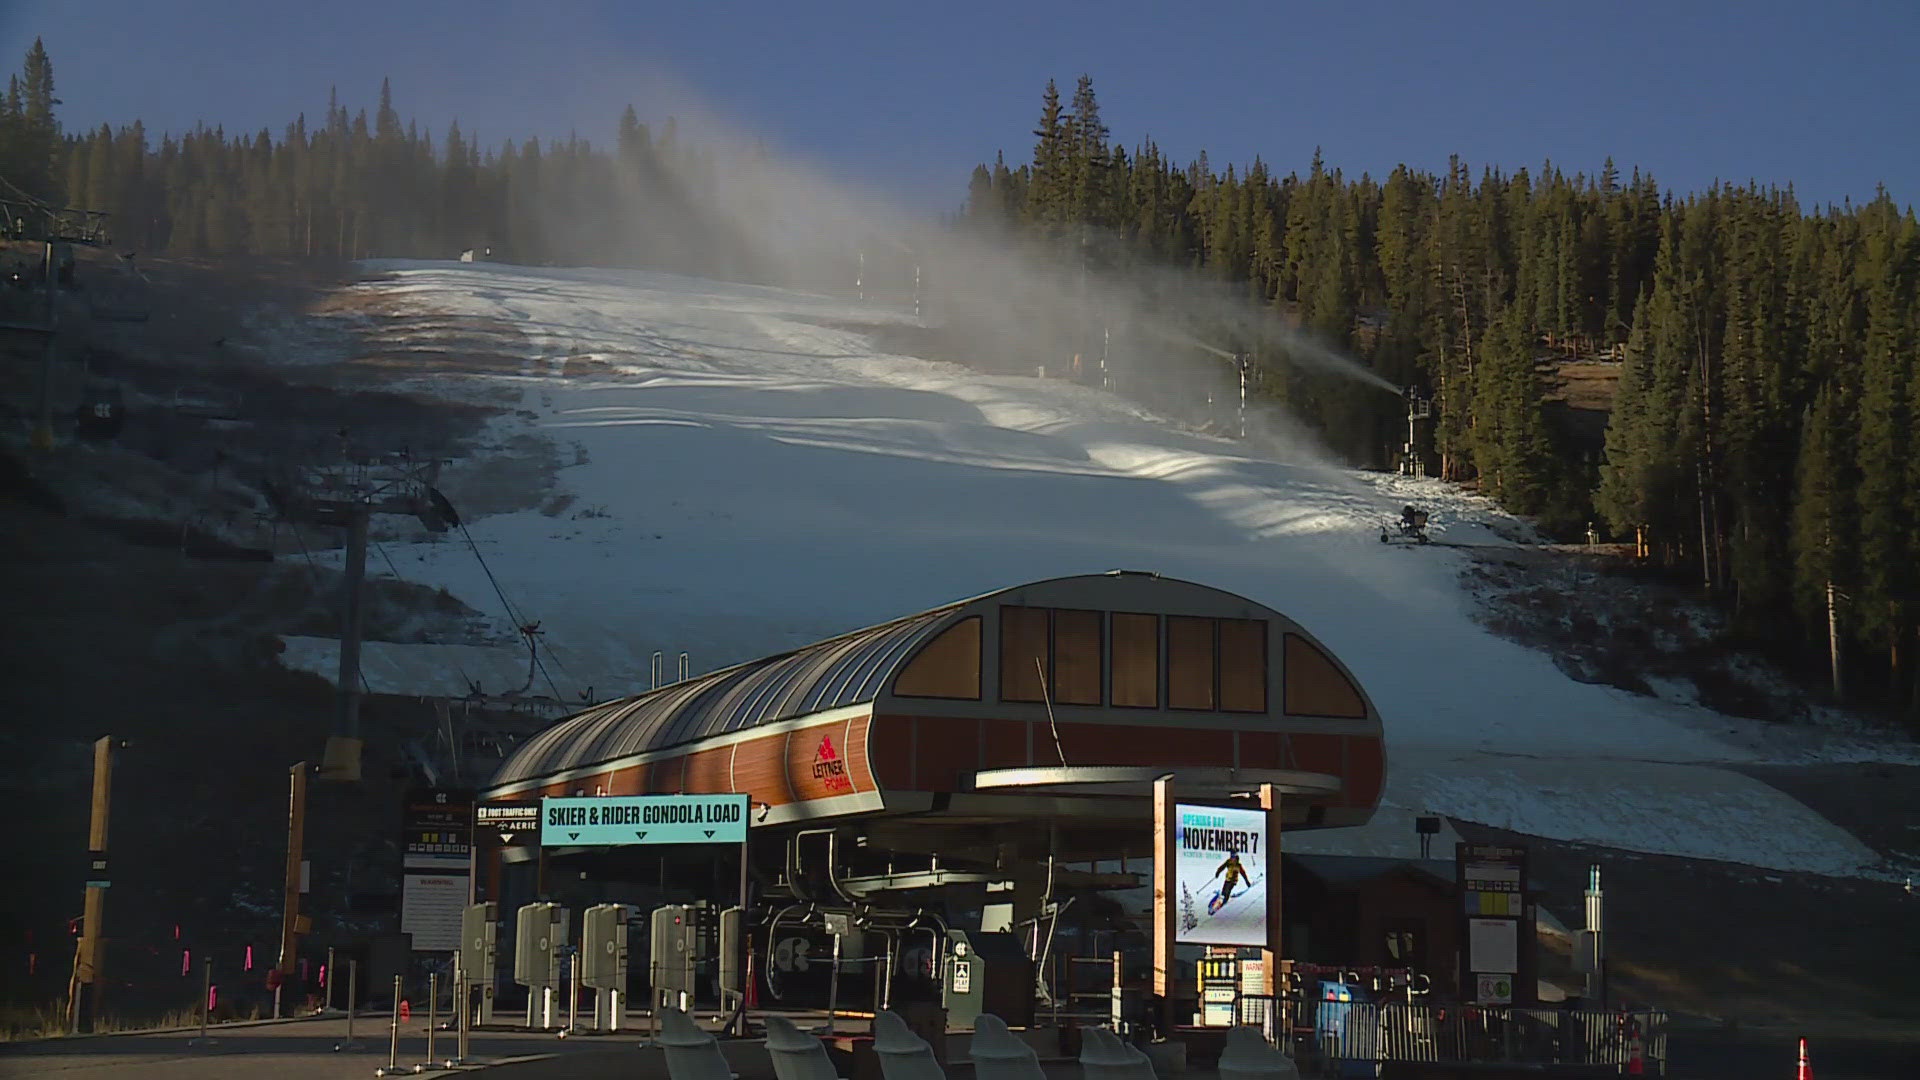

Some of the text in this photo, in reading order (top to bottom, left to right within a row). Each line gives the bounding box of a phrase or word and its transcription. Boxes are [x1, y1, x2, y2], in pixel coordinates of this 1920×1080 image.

[549, 804, 740, 826] SKIER & RIDER GONDOLA LOAD
[1183, 814, 1225, 827] OPENING DAY
[509, 822, 537, 830] AERIE
[1183, 827, 1259, 854] NOVEMBER 7
